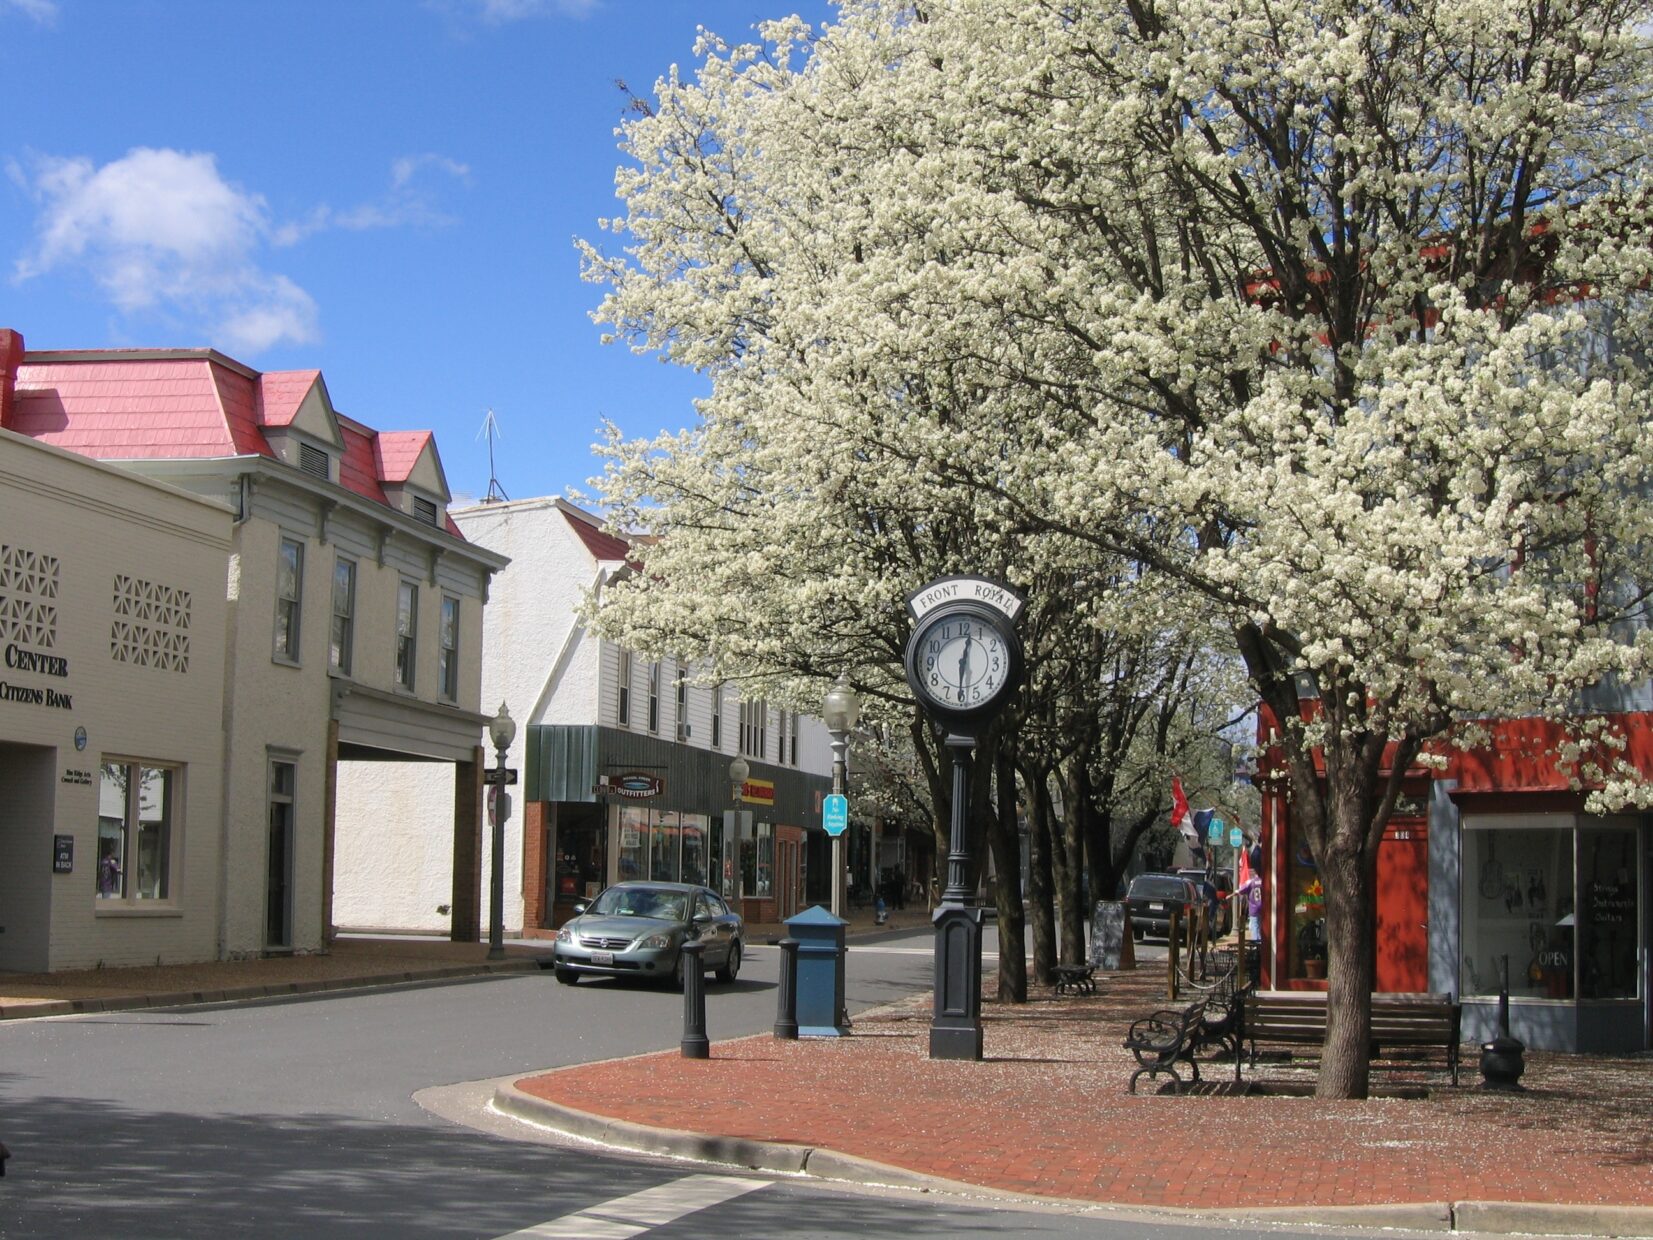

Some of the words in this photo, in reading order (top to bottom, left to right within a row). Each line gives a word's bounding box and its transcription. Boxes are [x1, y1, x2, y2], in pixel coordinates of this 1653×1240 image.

[919, 584, 959, 609] FRONT
[974, 584, 1013, 611] ROYAL
[942, 627, 950, 639] 11
[958, 622, 970, 636] 12
[978, 627, 983, 640] 1
[929, 639, 941, 653] 10
[990, 639, 997, 653] 2
[5, 643, 68, 678] CENTER
[926, 656, 935, 672] 9
[991, 657, 999, 672] 3
[930, 672, 939, 687] 8
[985, 675, 994, 690] 4
[0, 681, 44, 705] CITIZENS
[46, 688, 73, 710] BANK
[941, 685, 951, 699] 7
[957, 689, 965, 703] 6
[972, 685, 980, 699] 5
[617, 787, 656, 798] OUTFITTERS
[1538, 951, 1568, 966] OPEN
